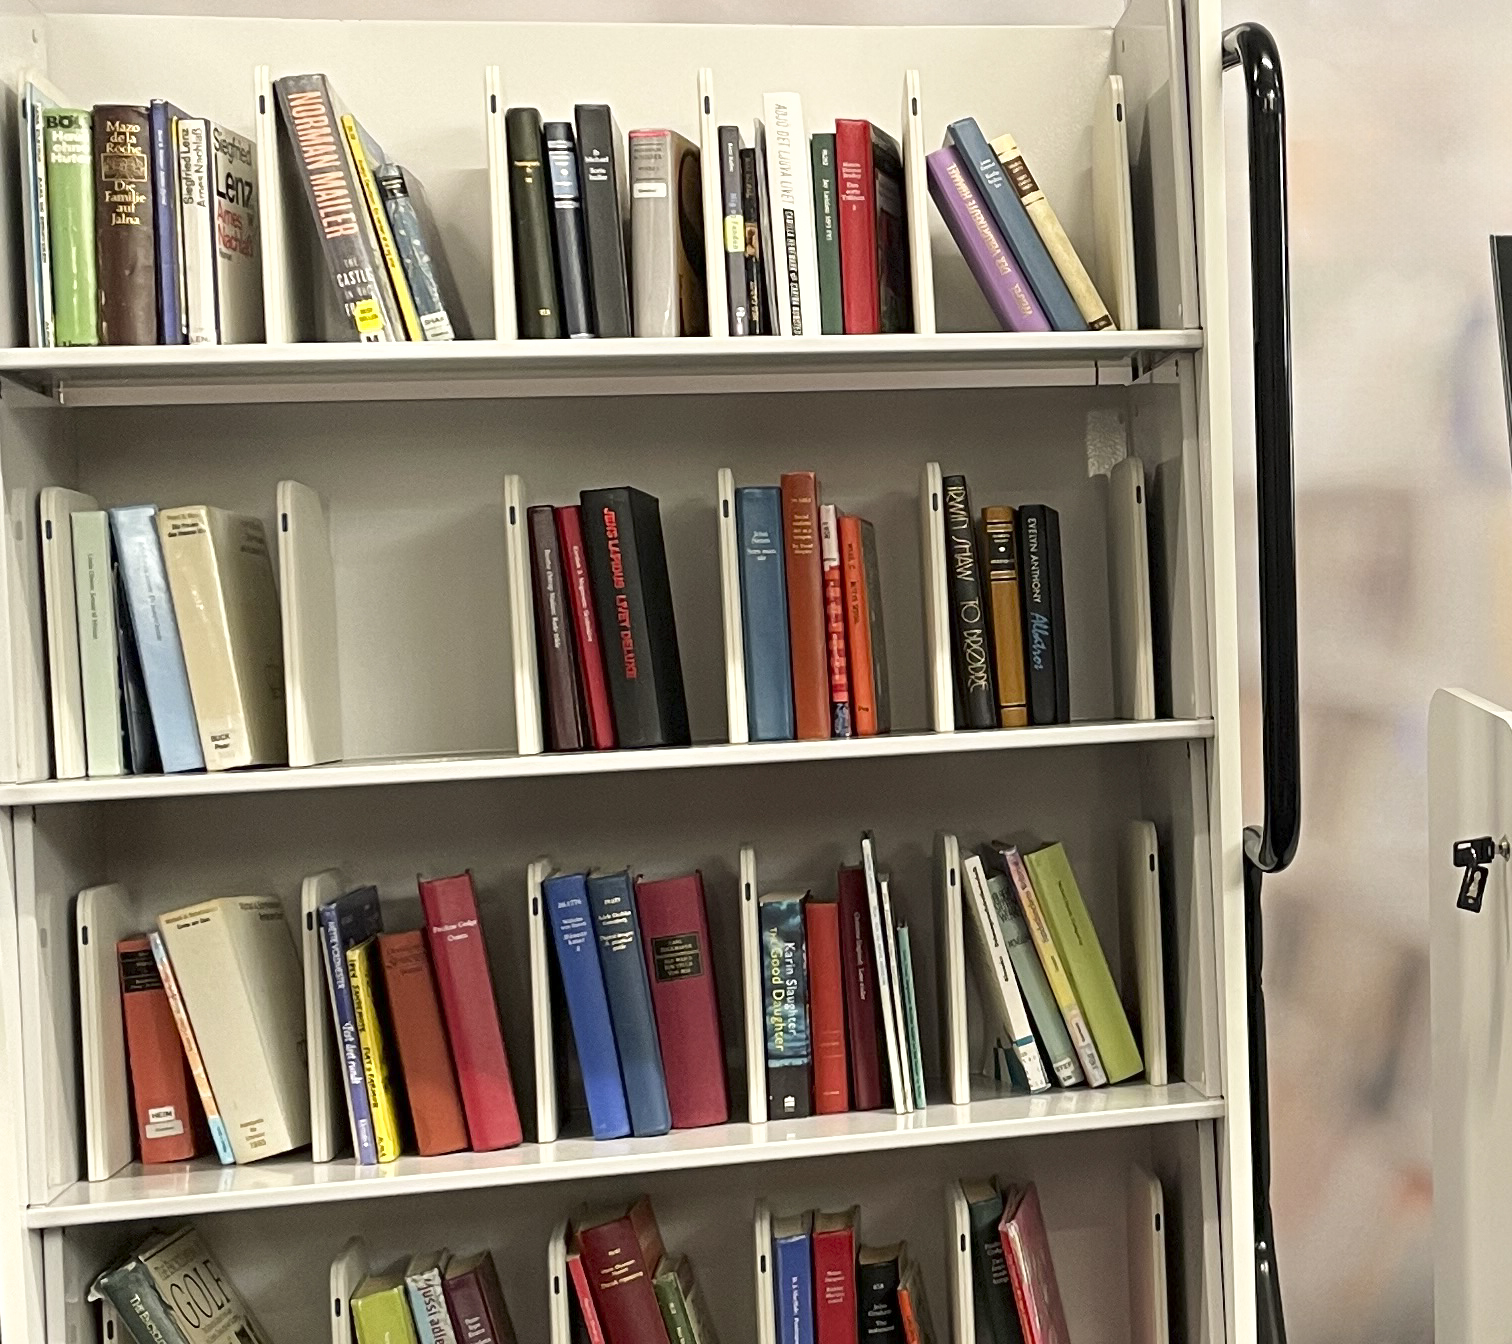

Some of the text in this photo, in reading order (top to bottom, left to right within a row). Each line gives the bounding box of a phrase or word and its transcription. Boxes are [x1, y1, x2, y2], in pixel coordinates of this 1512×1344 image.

[106, 121, 141, 133] Mazo
[110, 133, 137, 143] de la
[213, 127, 253, 166] Siegfried
[106, 143, 142, 155] Roche
[182, 127, 195, 205] Siegfried Lenz
[288, 91, 358, 240] NORMAN MAILER
[114, 180, 136, 191] Die
[215, 153, 253, 209] Lenz
[111, 213, 141, 226] Jalna
[116, 203, 136, 214] auf
[337, 268, 374, 288] CASTLE
[1027, 517, 1038, 553] EVELYN
[603, 507, 638, 679] JENS LAPIDUS LIVET DELUXE
[946, 486, 988, 692] IRWIN SHAW TO BRØDRE
[1030, 553, 1042, 604] ANTHONY
[770, 948, 783, 984] Good
[784, 942, 798, 1037] Karin Slaughter
[771, 989, 785, 1052] Daughter
[170, 1259, 231, 1329] GOLF
